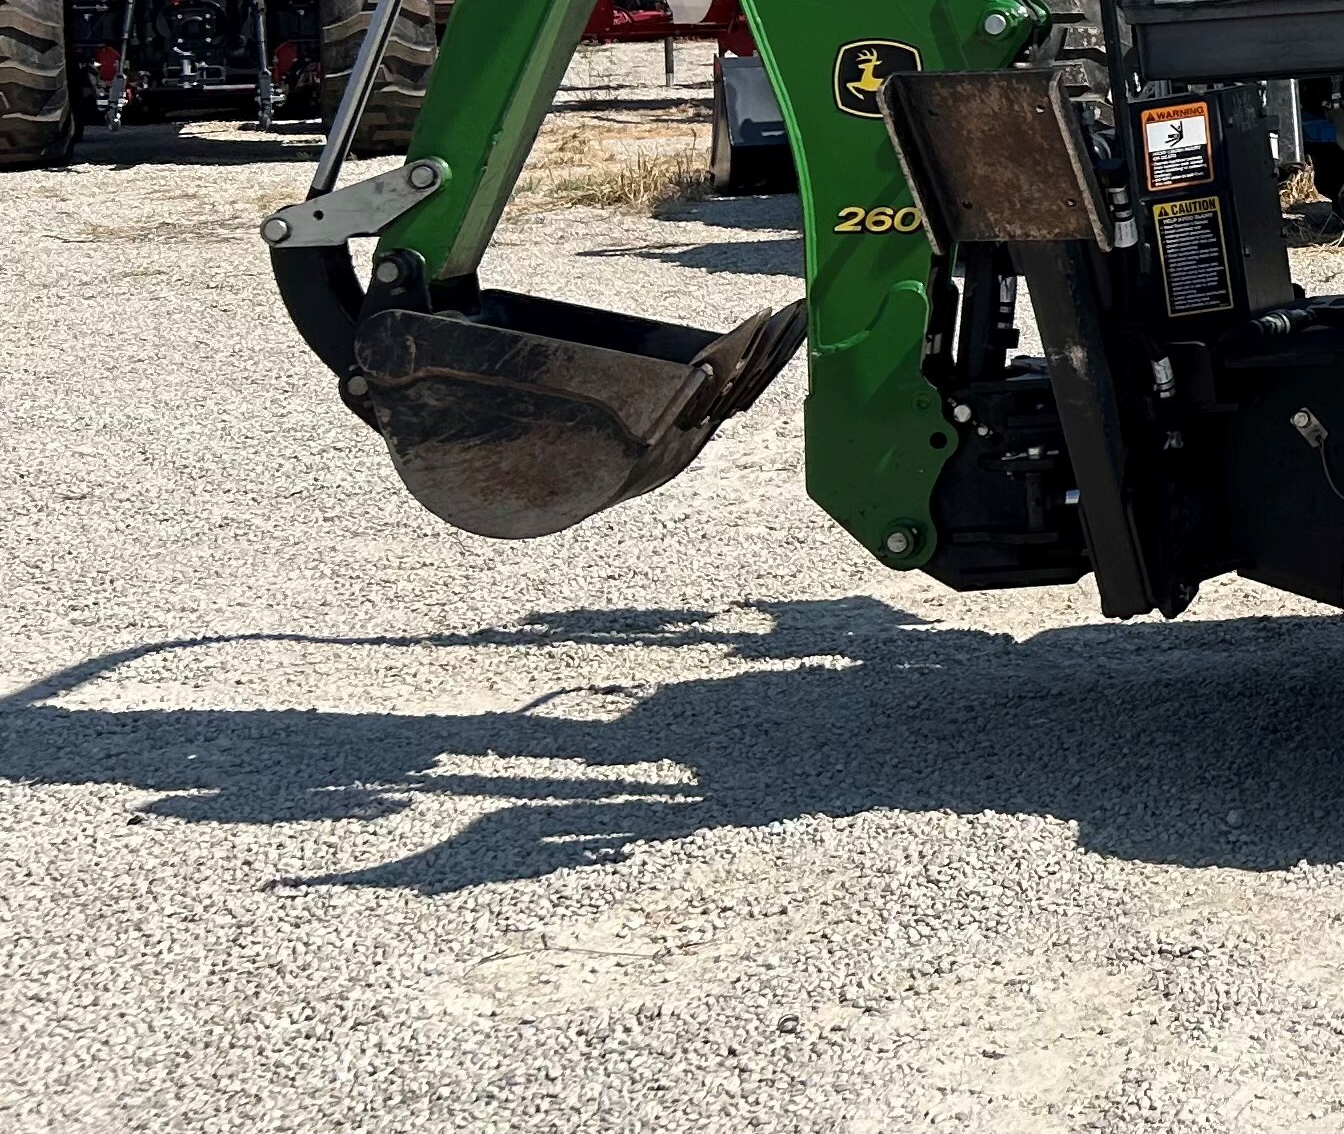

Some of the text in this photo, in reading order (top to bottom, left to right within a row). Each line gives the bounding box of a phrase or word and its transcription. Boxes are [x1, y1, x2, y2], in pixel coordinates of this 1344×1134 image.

[1156, 106, 1205, 121] WARNING
[1171, 198, 1216, 216] CAUTION
[834, 206, 923, 233] 260
